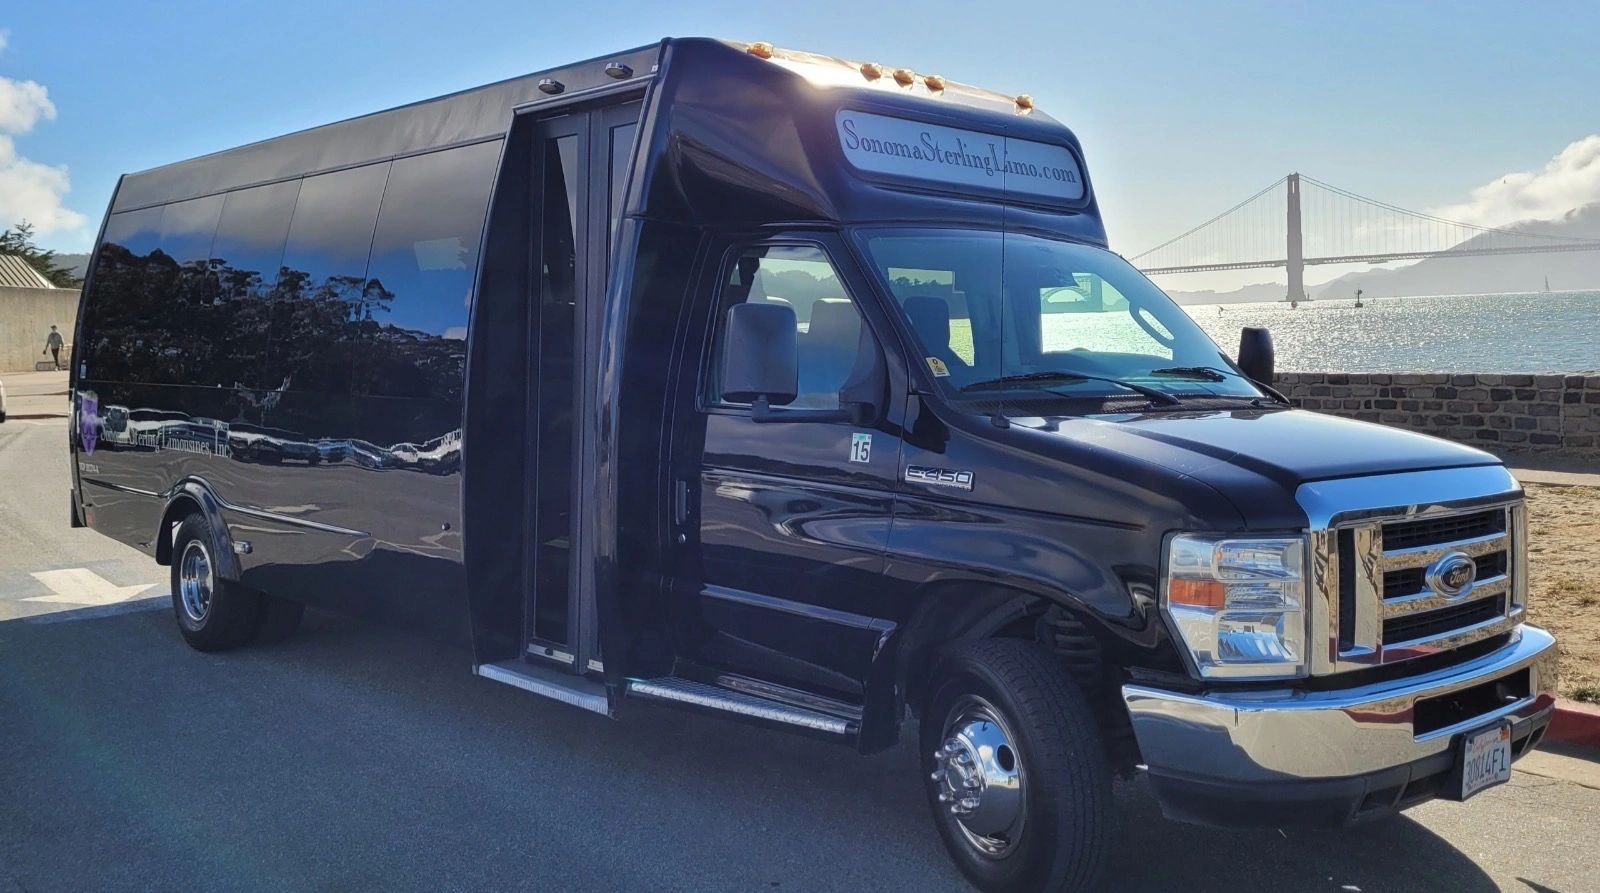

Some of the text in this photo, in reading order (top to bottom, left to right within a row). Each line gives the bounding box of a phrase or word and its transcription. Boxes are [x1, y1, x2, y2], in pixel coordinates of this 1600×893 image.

[842, 119, 1077, 184] SonomaSterlingLimo.com
[853, 440, 870, 461] 15
[907, 465, 972, 484] E-450
